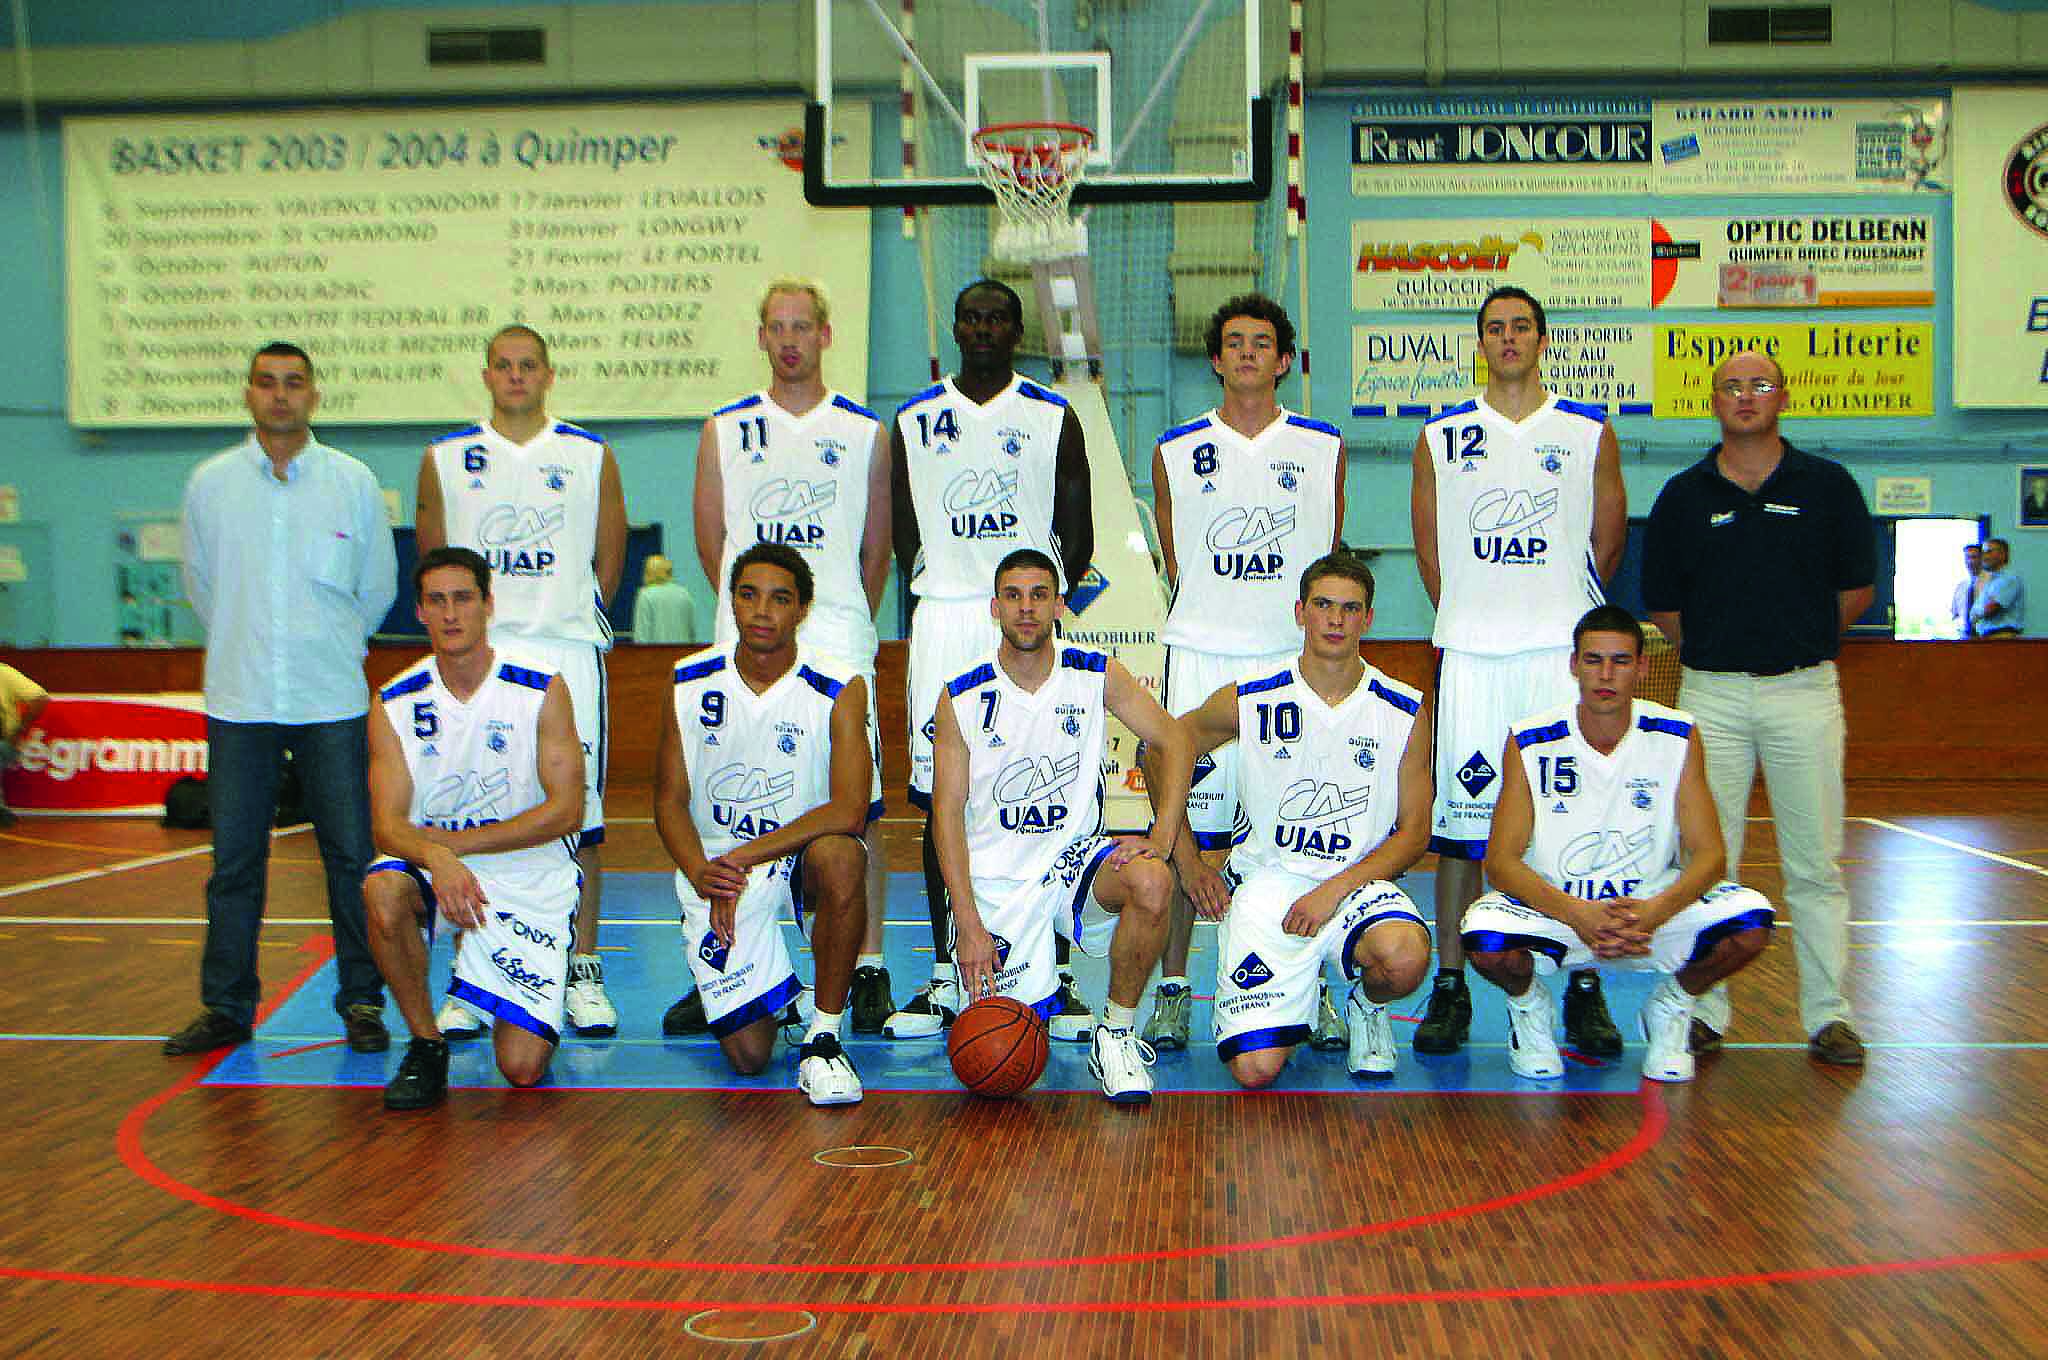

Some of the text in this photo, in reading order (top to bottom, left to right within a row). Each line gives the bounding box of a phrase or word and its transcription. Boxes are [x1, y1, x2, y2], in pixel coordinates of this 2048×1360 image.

[110, 135, 248, 176] BASKET
[260, 134, 347, 172] 2003
[376, 131, 467, 168] 2004
[513, 127, 678, 172] Quimper
[1456, 124, 1646, 161] JONCOUR
[1727, 219, 1927, 242] OPTIC DELBENN
[1728, 247, 1926, 263] QUIMPER BRIEC FOUESNANT
[1396, 273, 1495, 296] autocars
[1726, 265, 1747, 290] 2
[1368, 335, 1457, 363] DUVAL
[1584, 328, 1633, 343] PORTES
[1667, 327, 1922, 366] Espace Literie
[1544, 346, 1606, 361] PVC ALU
[1550, 365, 1615, 379] QUIMPER
[1591, 383, 1610, 399] 42
[1809, 392, 1912, 411] QUIMPER
[739, 417, 768, 451] 11
[917, 408, 961, 448] 14
[1443, 424, 1487, 464] 12
[465, 444, 490, 473] 6
[1193, 442, 1220, 477] 8
[755, 522, 826, 545] UJAP
[951, 512, 1019, 538] UJAP
[484, 549, 557, 576] UJAP
[1473, 536, 1548, 563] UJAP
[1213, 552, 1285, 580] UJAP
[413, 700, 439, 740] 5
[700, 690, 729, 731] 9
[980, 690, 1001, 732] 7
[1257, 702, 1303, 744] 10
[19, 728, 209, 782] égramm
[1538, 756, 1582, 797] 15
[1275, 825, 1352, 855] UJAP
